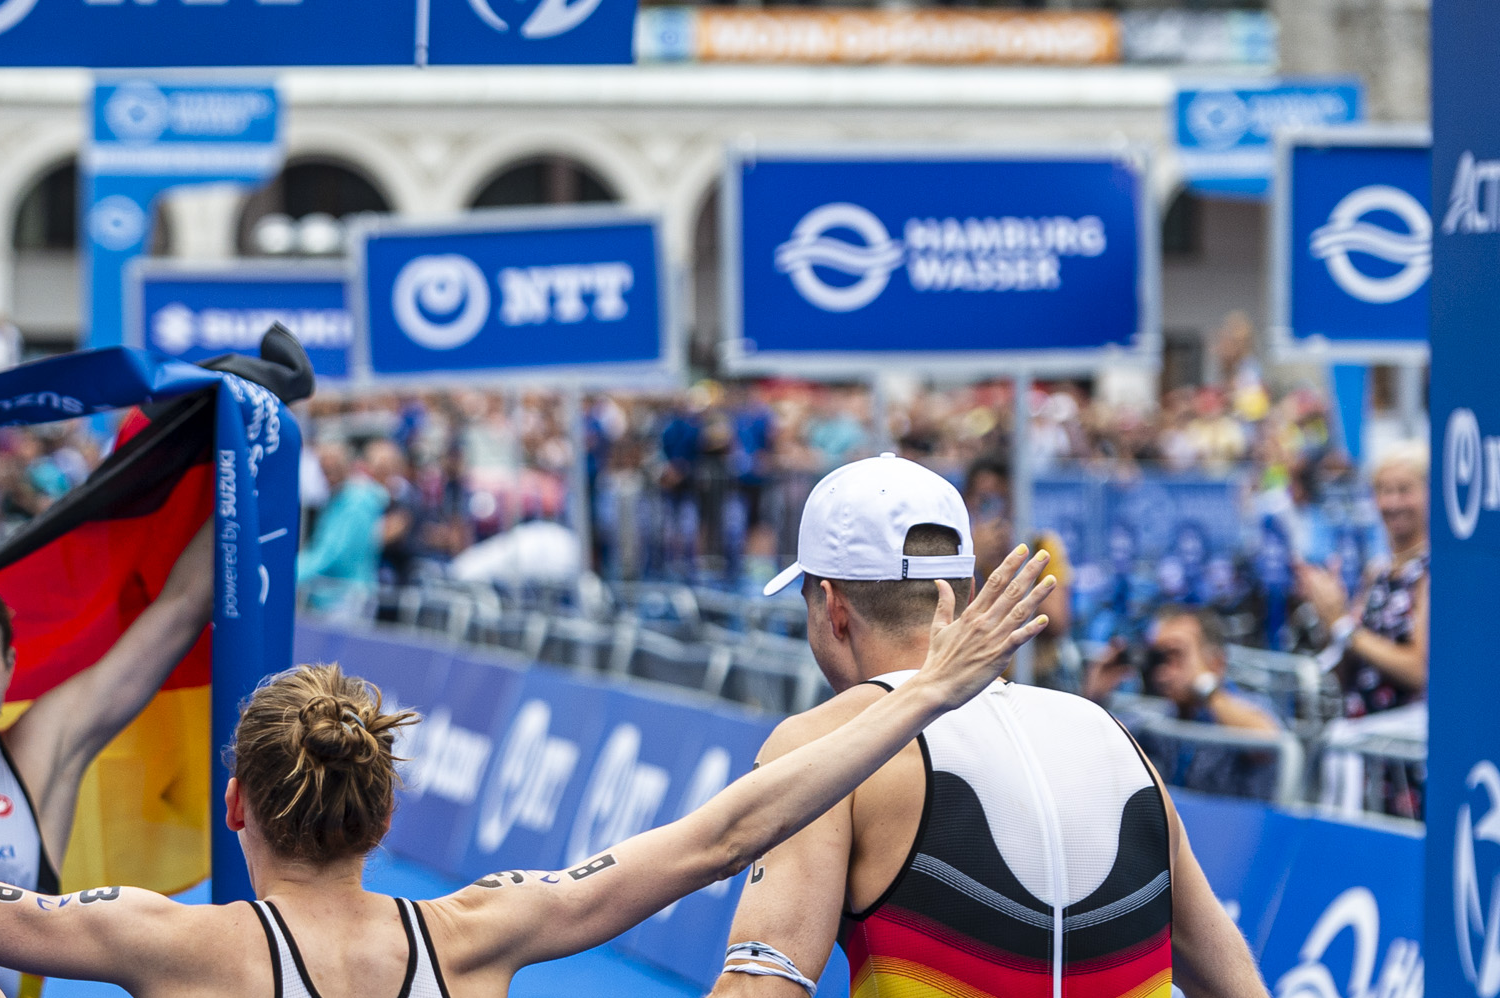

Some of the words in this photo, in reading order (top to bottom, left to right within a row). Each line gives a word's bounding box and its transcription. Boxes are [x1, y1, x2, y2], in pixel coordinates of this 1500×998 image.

[498, 262, 634, 326] NTT
[219, 449, 237, 518] SUZUKI
[222, 542, 241, 618] powered
